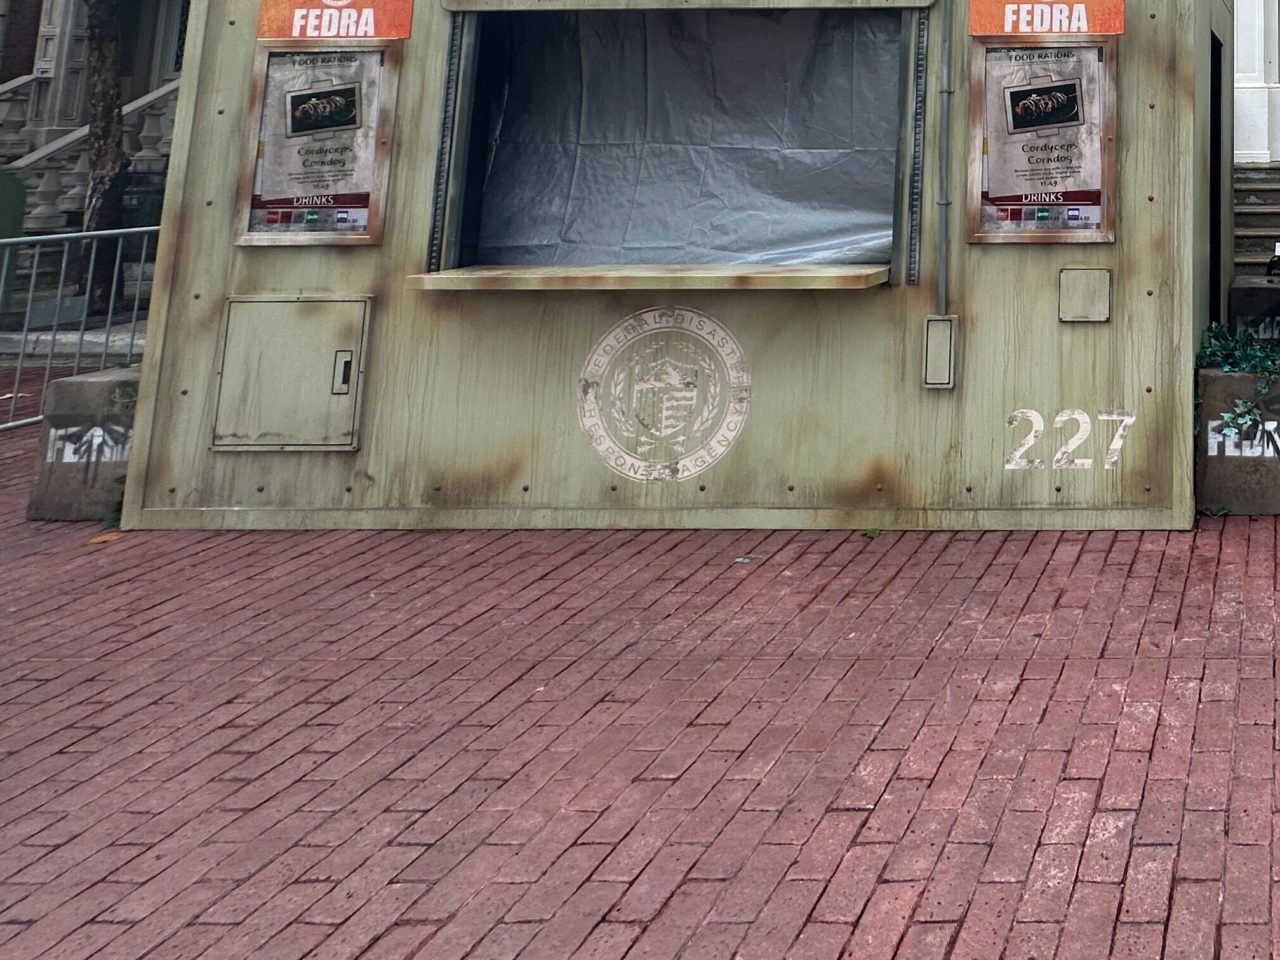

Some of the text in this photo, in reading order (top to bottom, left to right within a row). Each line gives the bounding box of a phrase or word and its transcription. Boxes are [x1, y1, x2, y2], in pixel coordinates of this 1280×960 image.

[291, 8, 376, 37] FEDRA
[1004, 4, 1088, 32] FEDRA
[1010, 52, 1035, 62] FOOD
[1038, 51, 1075, 61] RATIONS
[1021, 143, 1079, 154] Cordyceps
[1027, 154, 1073, 165] Corndog
[293, 195, 335, 206] DRINKS
[1022, 192, 1064, 203] DRINKS
[1004, 408, 1137, 471] 227
